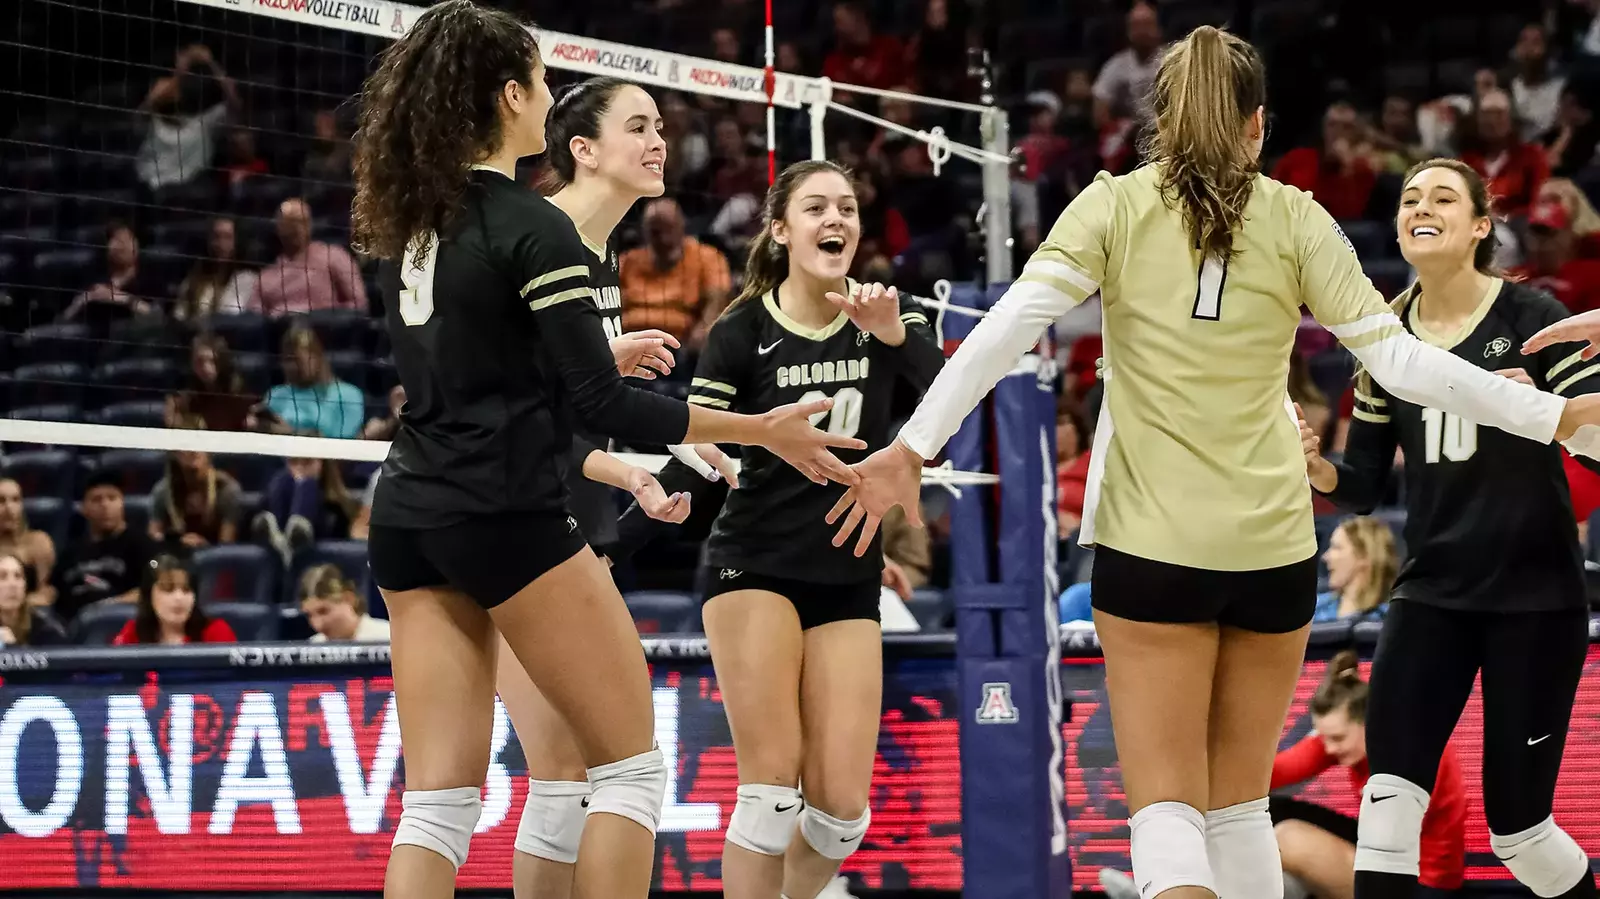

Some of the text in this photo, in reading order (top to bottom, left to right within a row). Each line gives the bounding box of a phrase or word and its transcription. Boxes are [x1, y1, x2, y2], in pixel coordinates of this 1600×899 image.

[399, 229, 439, 326] 9
[1191, 245, 1228, 321] 1
[777, 357, 869, 388] COLORADO
[798, 387, 863, 438] 20
[1422, 407, 1478, 464] 10
[975, 682, 1019, 724] A
